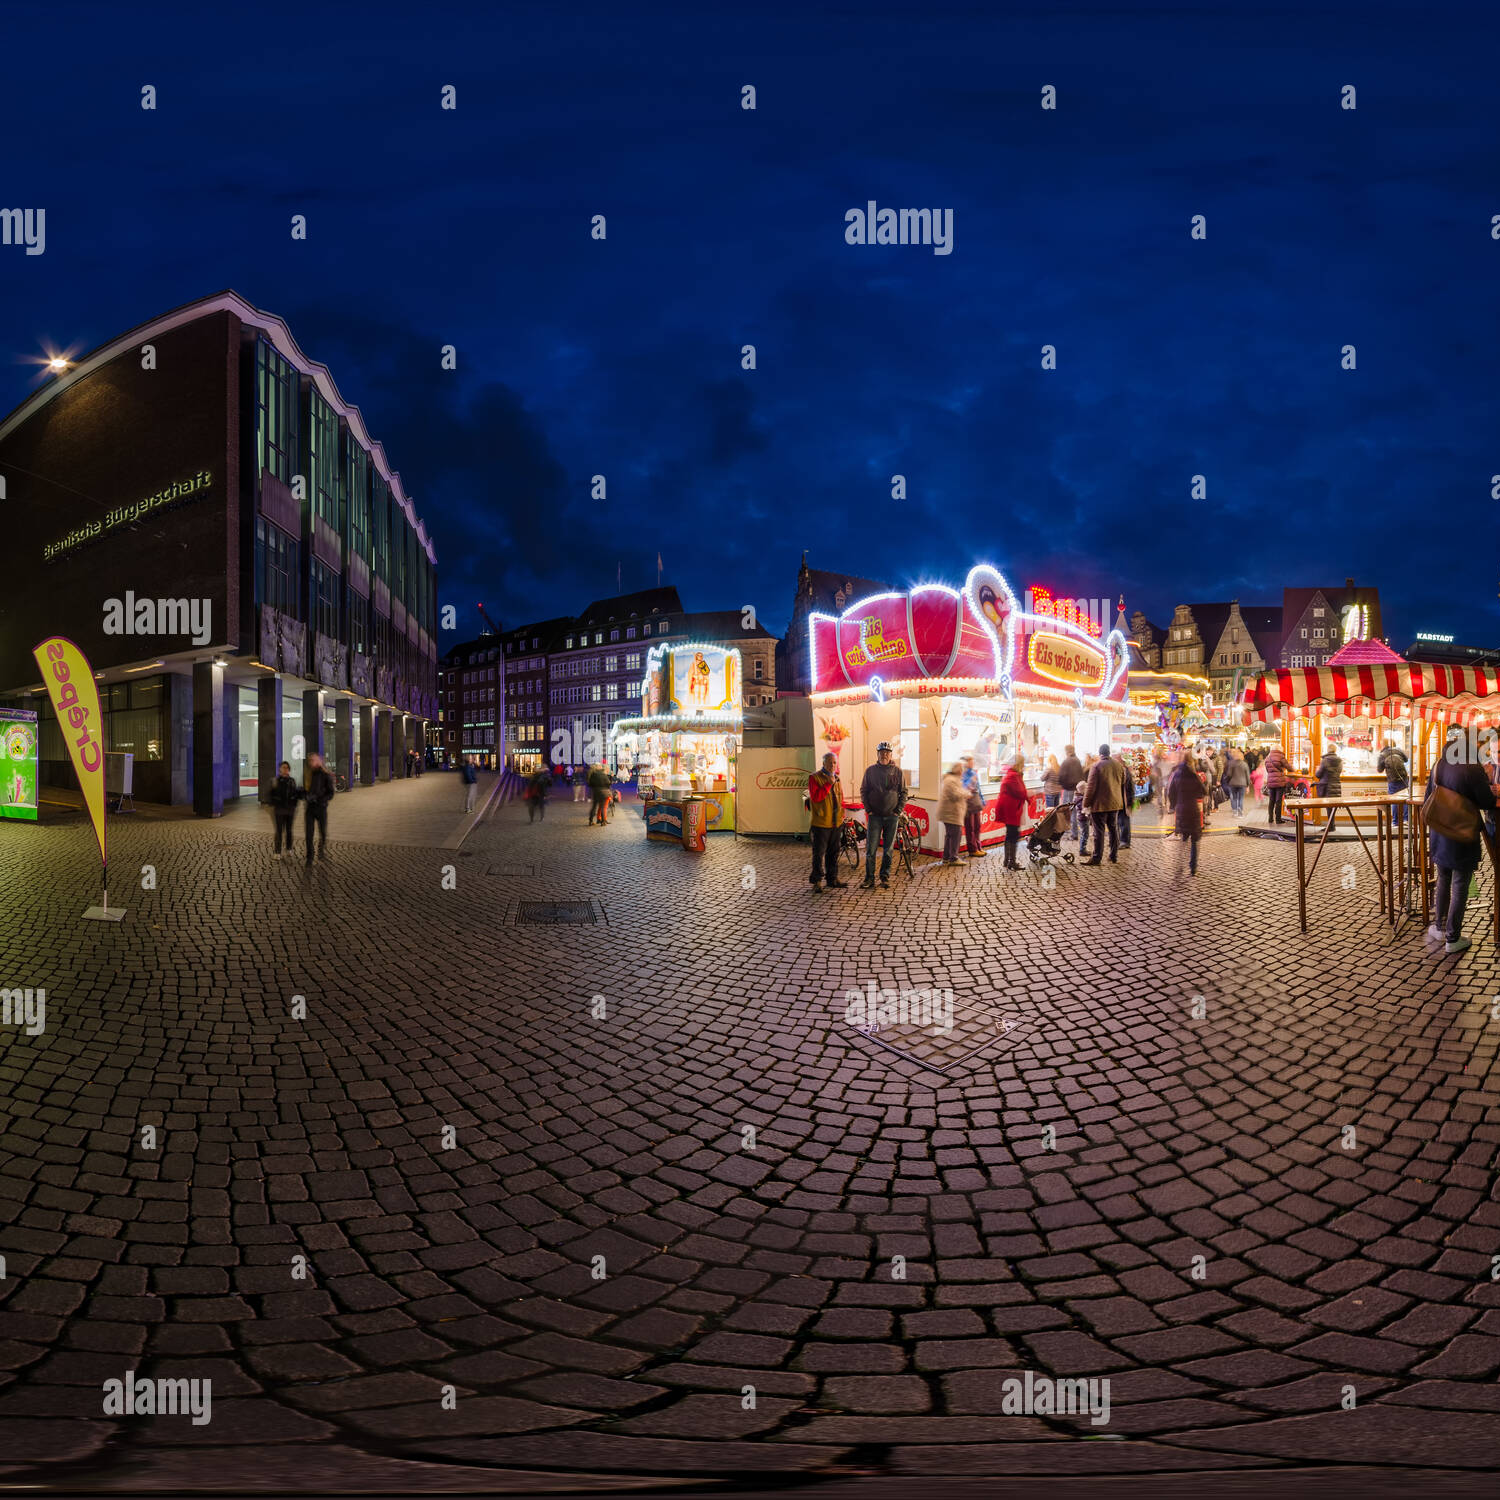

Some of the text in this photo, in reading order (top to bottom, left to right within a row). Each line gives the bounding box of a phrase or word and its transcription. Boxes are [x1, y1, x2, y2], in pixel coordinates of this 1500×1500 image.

[43, 471, 212, 560] Bremische Bürgerschaft
[1416, 632, 1454, 642] KARSTADT
[1036, 642, 1101, 679] Eis wie Sahne
[890, 684, 1000, 696] Eis Bohne Eis
